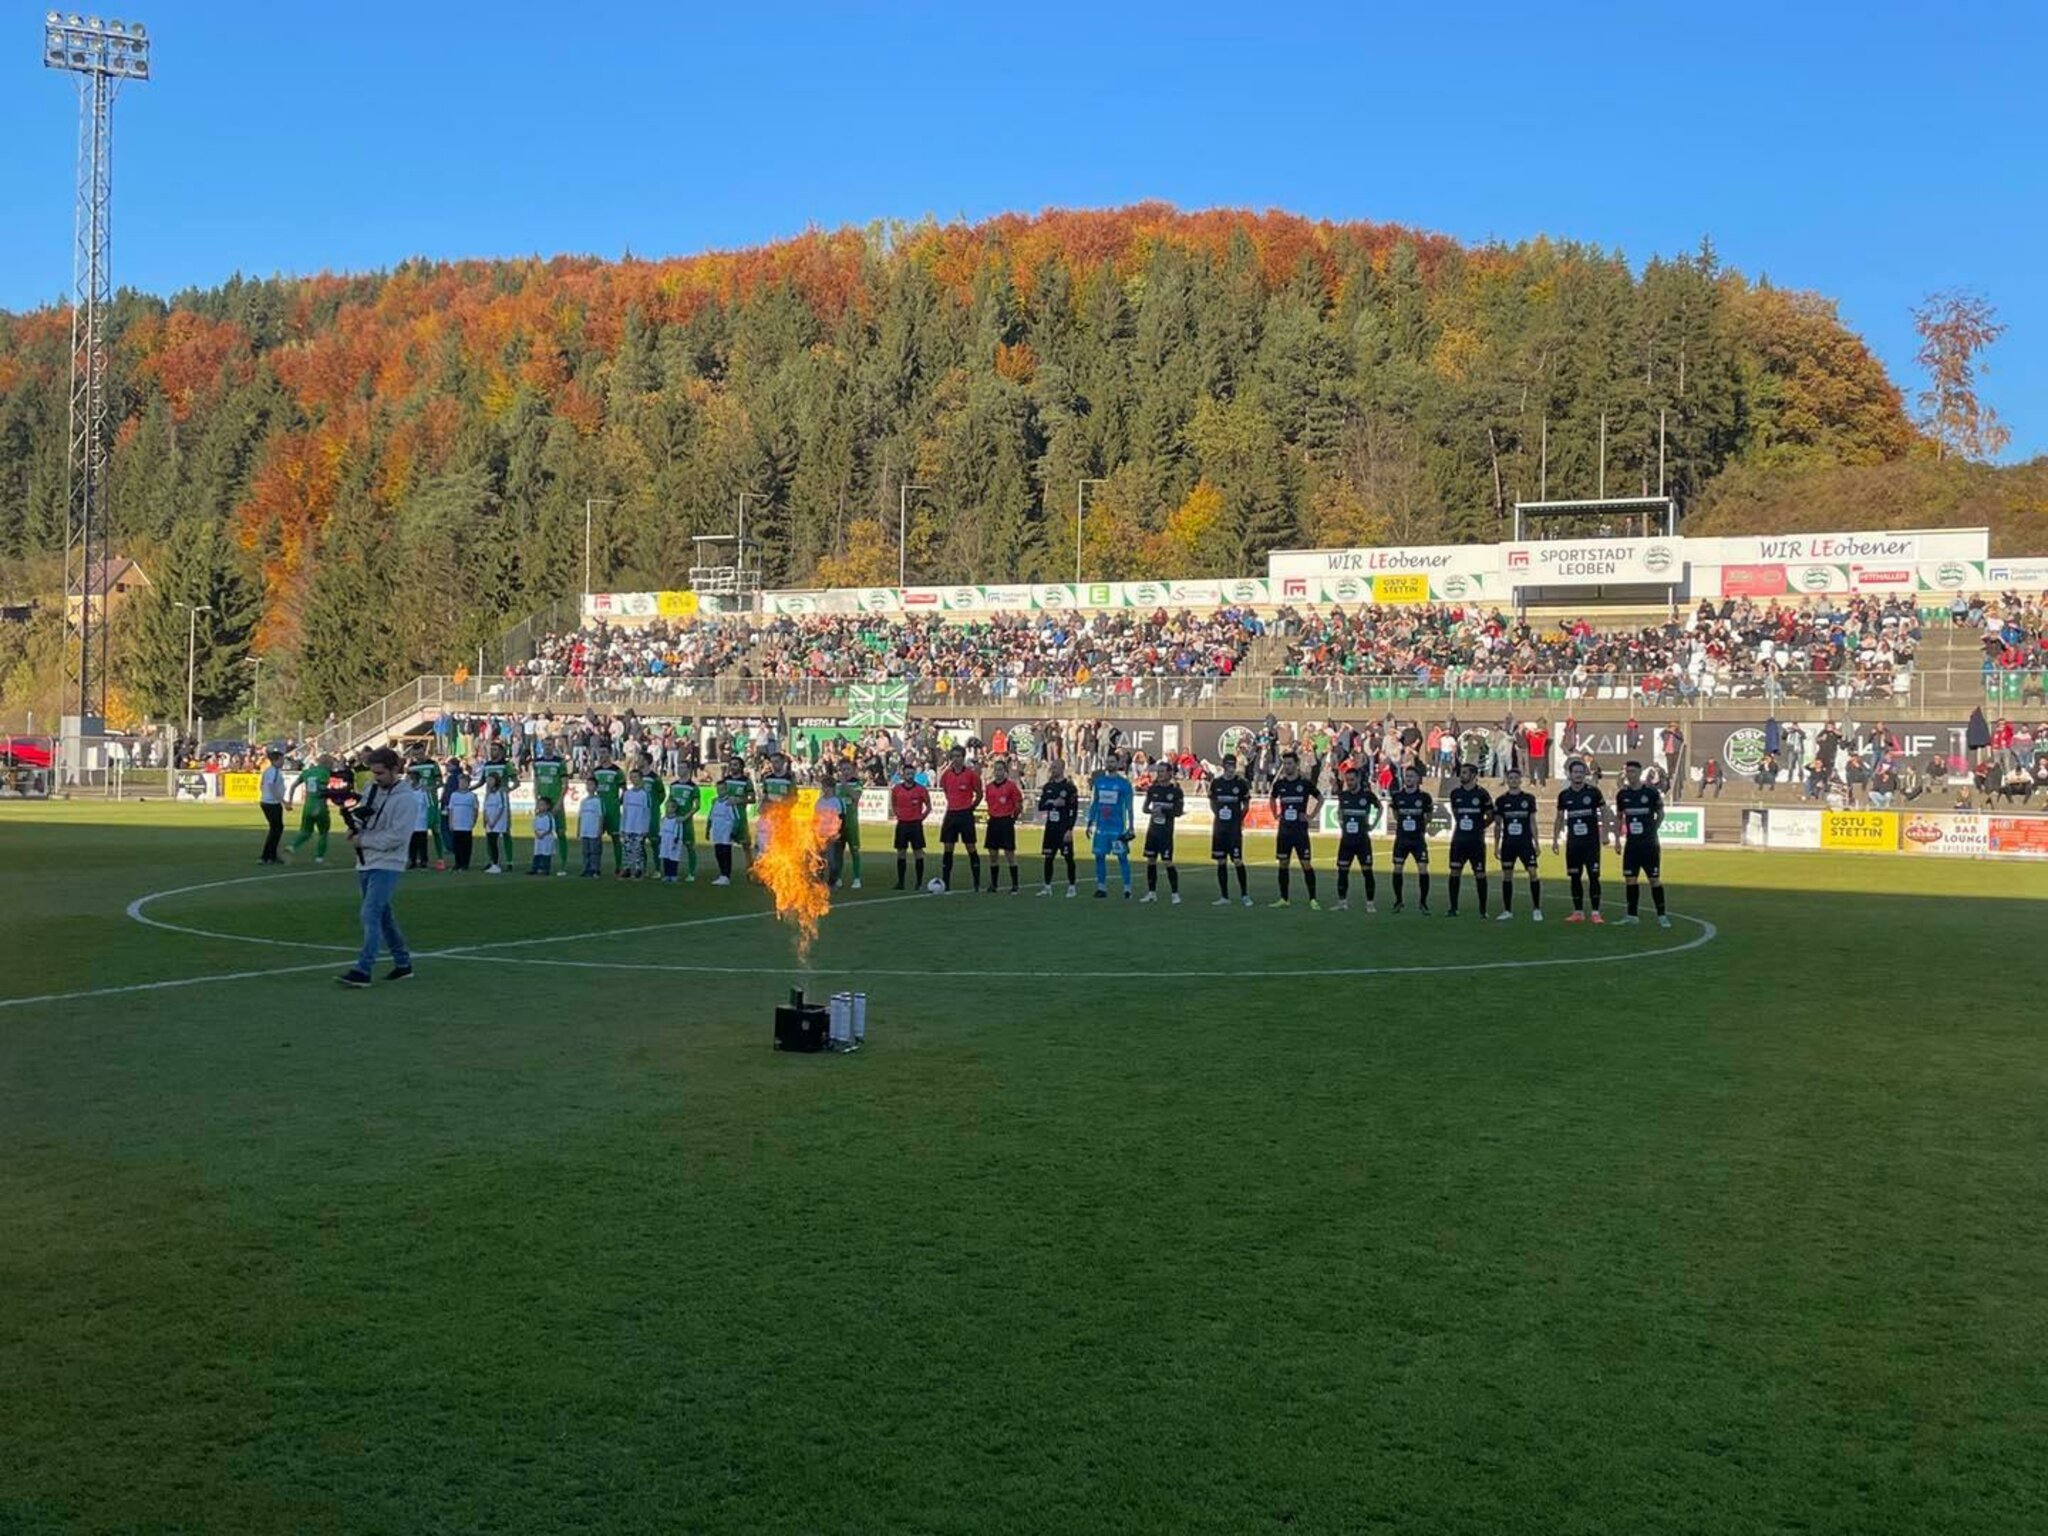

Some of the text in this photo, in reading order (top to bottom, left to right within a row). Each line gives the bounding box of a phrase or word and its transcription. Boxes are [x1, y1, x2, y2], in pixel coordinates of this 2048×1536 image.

[1540, 547, 1636, 562] SPORTSTADT
[1760, 537, 1912, 559] WIR LEobener
[1327, 553, 1452, 571] WIR LEobener
[1558, 562, 1616, 576] LEOBEN
[1831, 827, 1882, 838] STETTIN
[1944, 835, 1987, 844] LOUNGE
